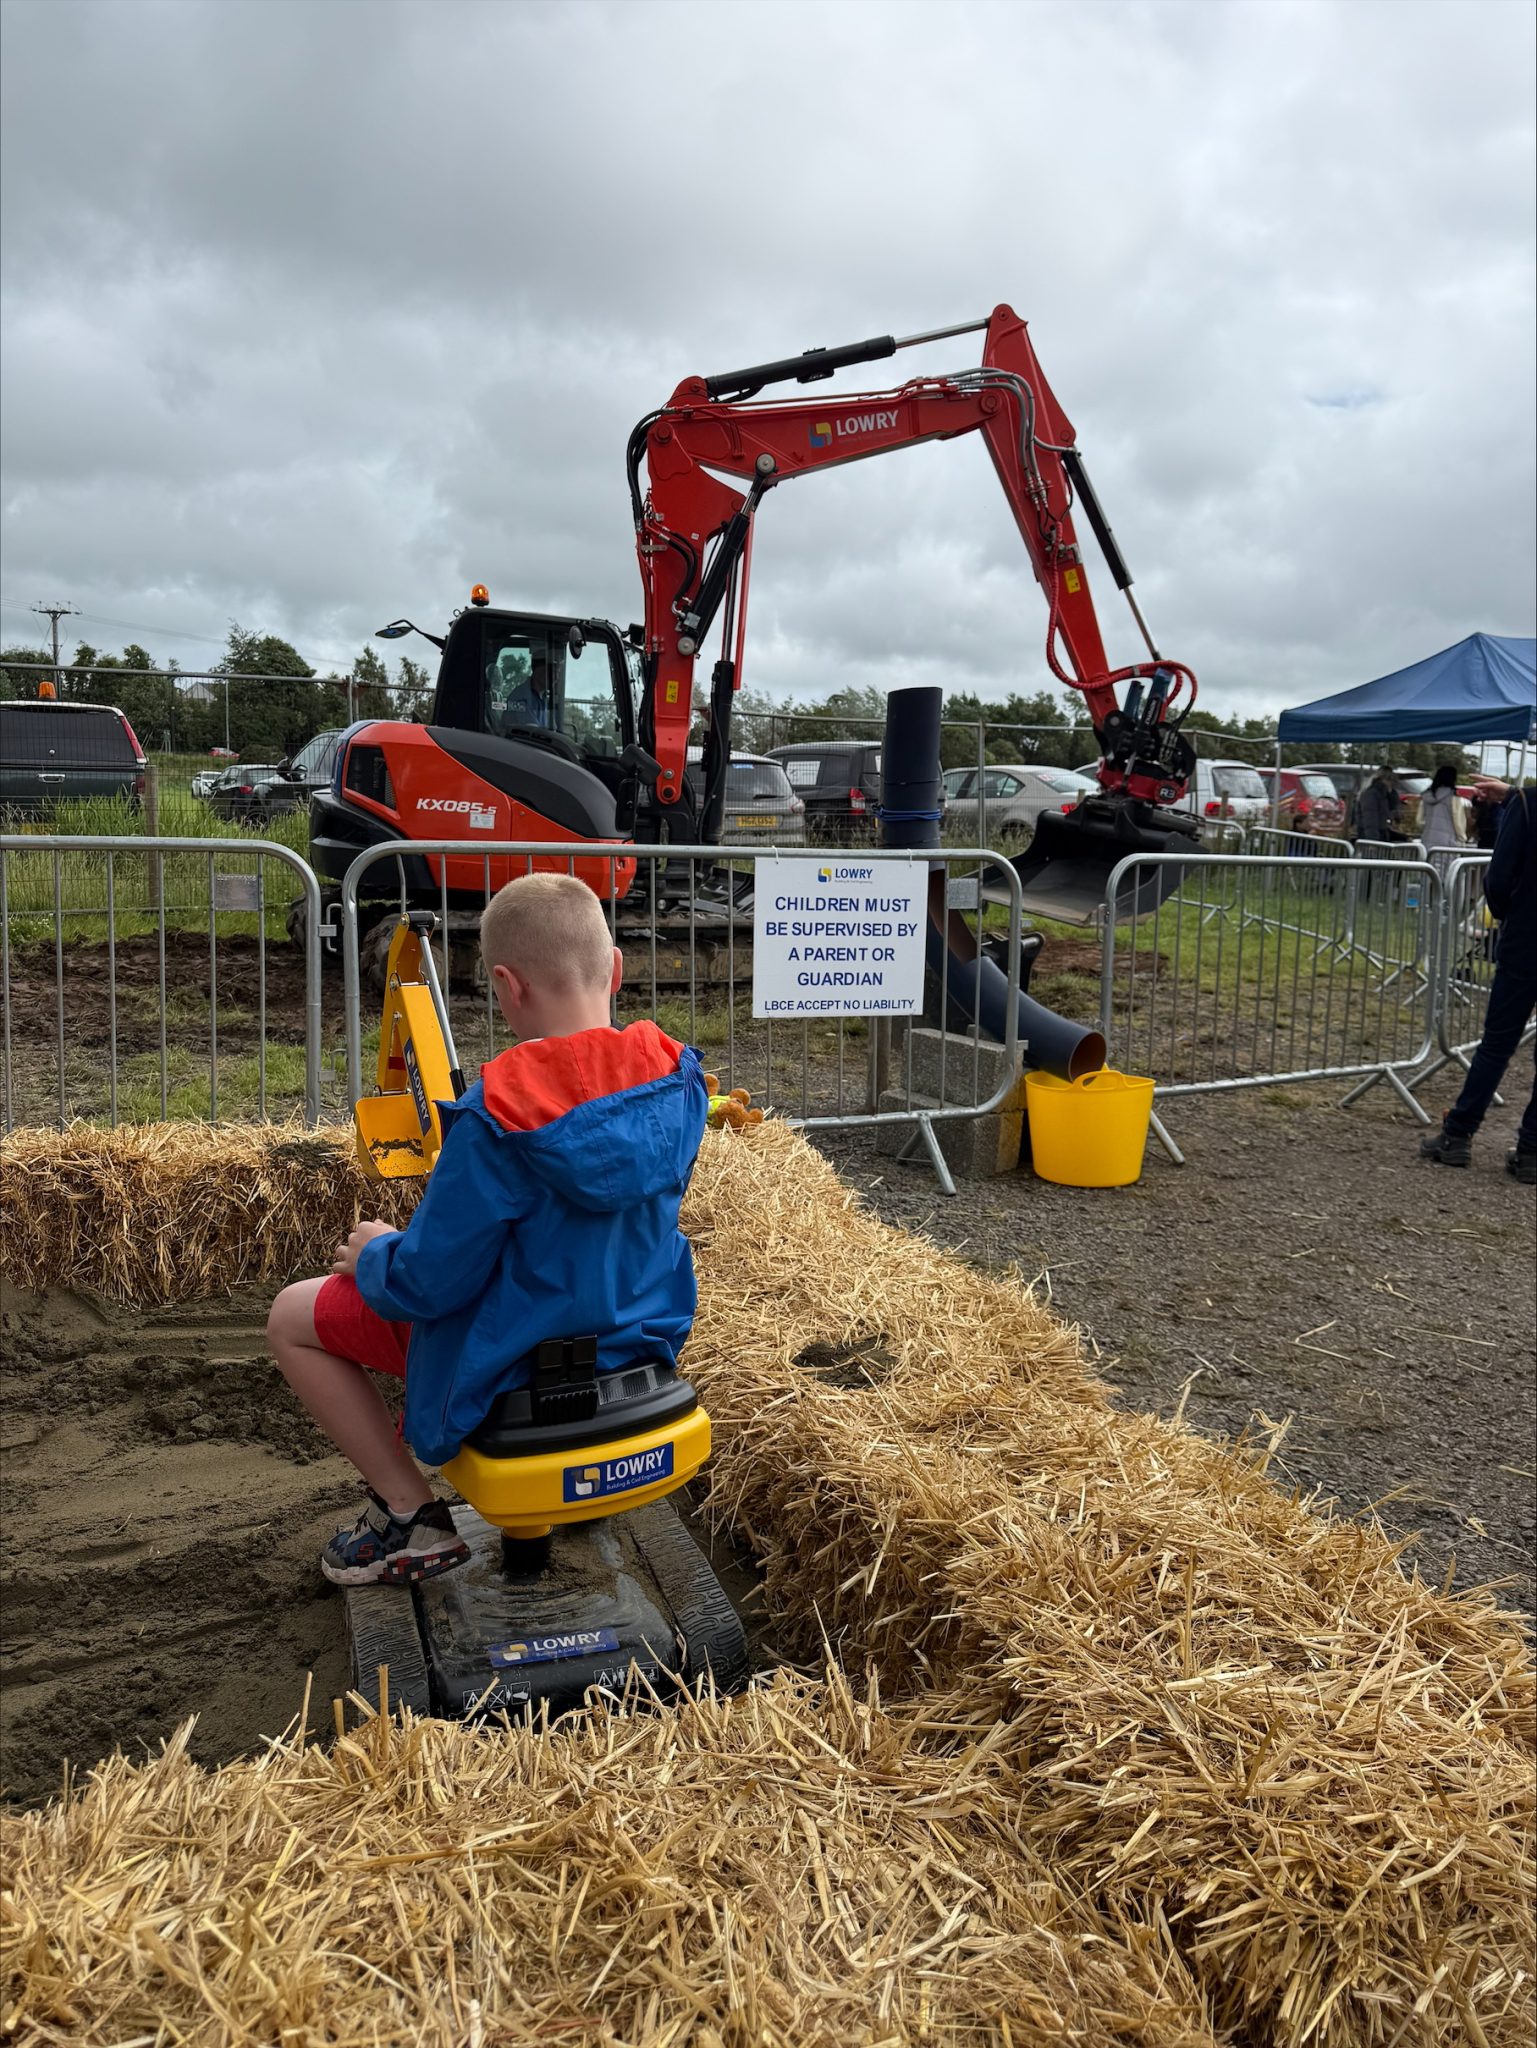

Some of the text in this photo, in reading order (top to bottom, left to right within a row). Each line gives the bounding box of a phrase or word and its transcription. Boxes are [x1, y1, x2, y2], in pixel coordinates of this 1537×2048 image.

[836, 409, 899, 437] LOWRY
[835, 868, 873, 879] LOWRY
[775, 896, 911, 912] CHILDREN MUST
[766, 922, 918, 937] BE SUPERVISED BY
[788, 947, 895, 961] A PARENT OR
[797, 972, 883, 986] GUARDIAN
[764, 999, 915, 1011] LBCE ACCEPT NO LIABILITY
[412, 1068, 429, 1119] LOWRY
[606, 1448, 666, 1482] LOWRY
[606, 1481, 626, 1490] Building
[533, 1631, 601, 1652] LOWRY
